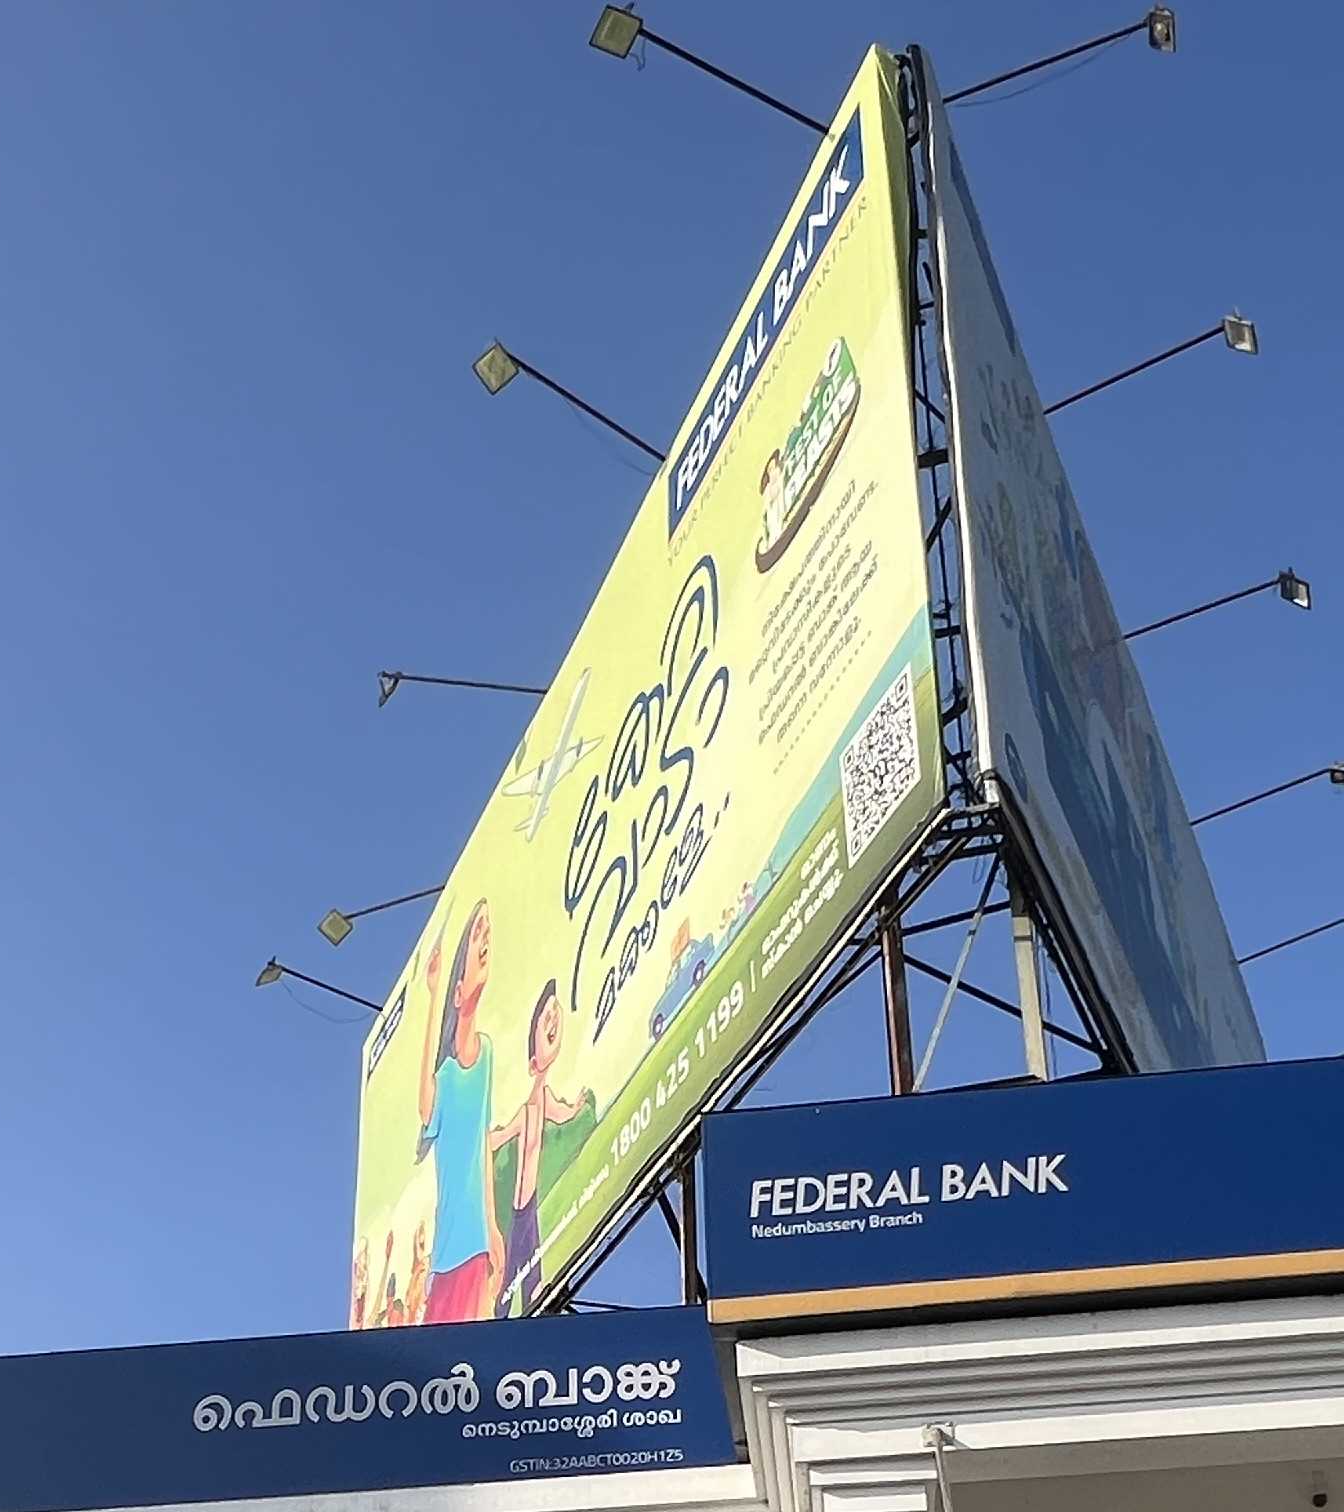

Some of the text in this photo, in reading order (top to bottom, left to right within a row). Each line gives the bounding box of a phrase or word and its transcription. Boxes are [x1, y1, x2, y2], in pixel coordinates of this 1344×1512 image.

[676, 144, 851, 511] FEDERAL BANK
[783, 372, 843, 475] FEST OF
[784, 372, 856, 508] FEASTS
[611, 980, 744, 1167] 1800 425 1199
[750, 1154, 1069, 1218] FEDERAL BANK
[751, 1211, 923, 1239] Nedumbassery Branch
[191, 1358, 682, 1432] ഫെഡറൽ ബാങ്ക്
[621, 1408, 682, 1427] ശാഖ
